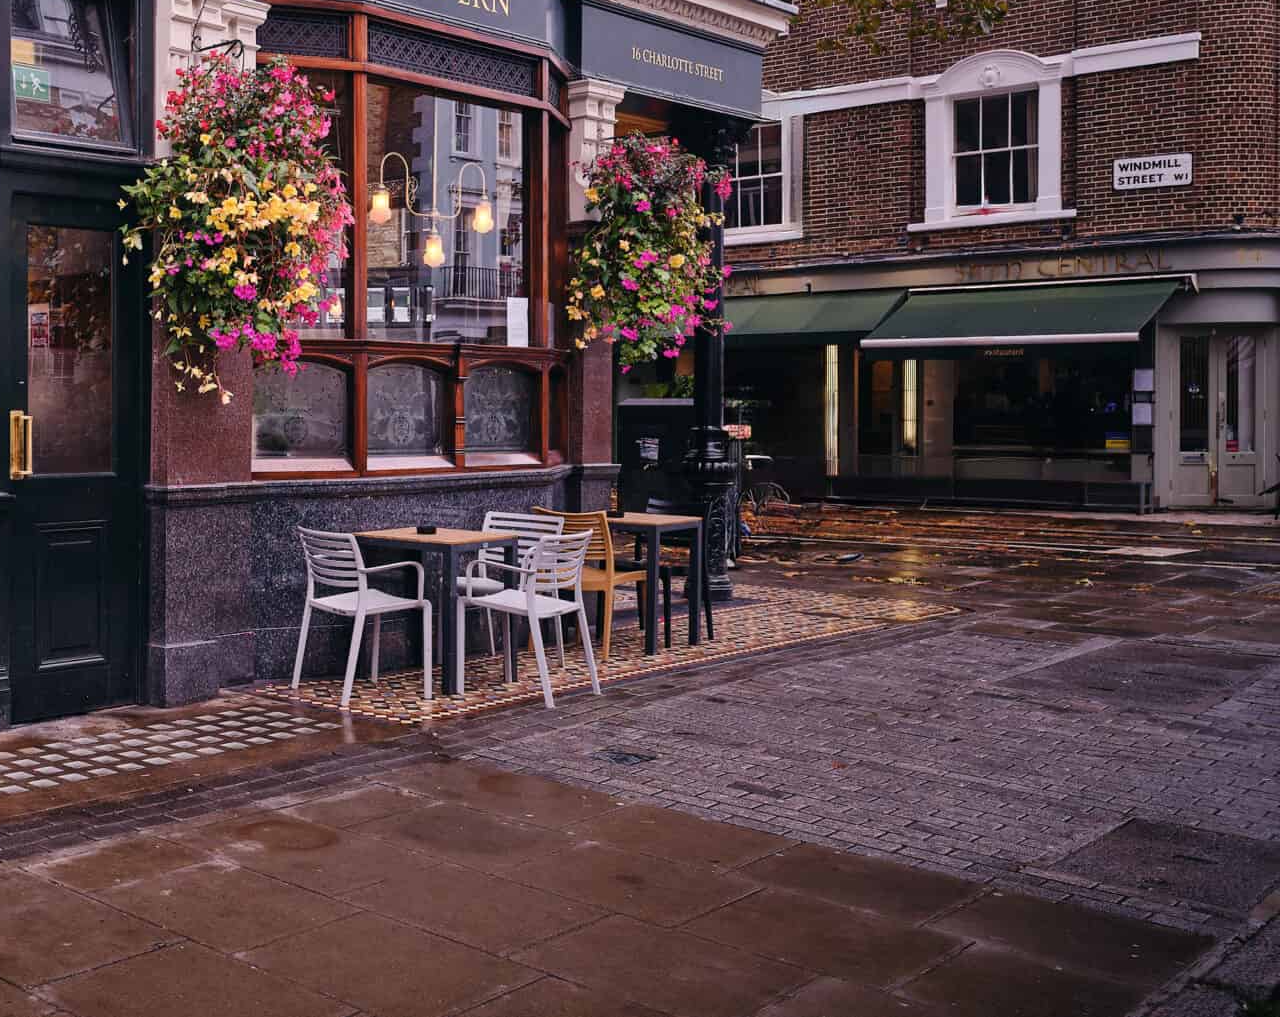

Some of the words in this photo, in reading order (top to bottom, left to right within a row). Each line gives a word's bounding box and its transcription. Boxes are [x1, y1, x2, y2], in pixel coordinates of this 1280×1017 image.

[632, 47, 641, 61] 16
[642, 49, 693, 74] CHARLOTTE
[695, 63, 724, 81] STREET
[1118, 158, 1182, 173] WINDMILL
[1118, 173, 1164, 186] STREET
[1037, 248, 1174, 278] CENTRAL
